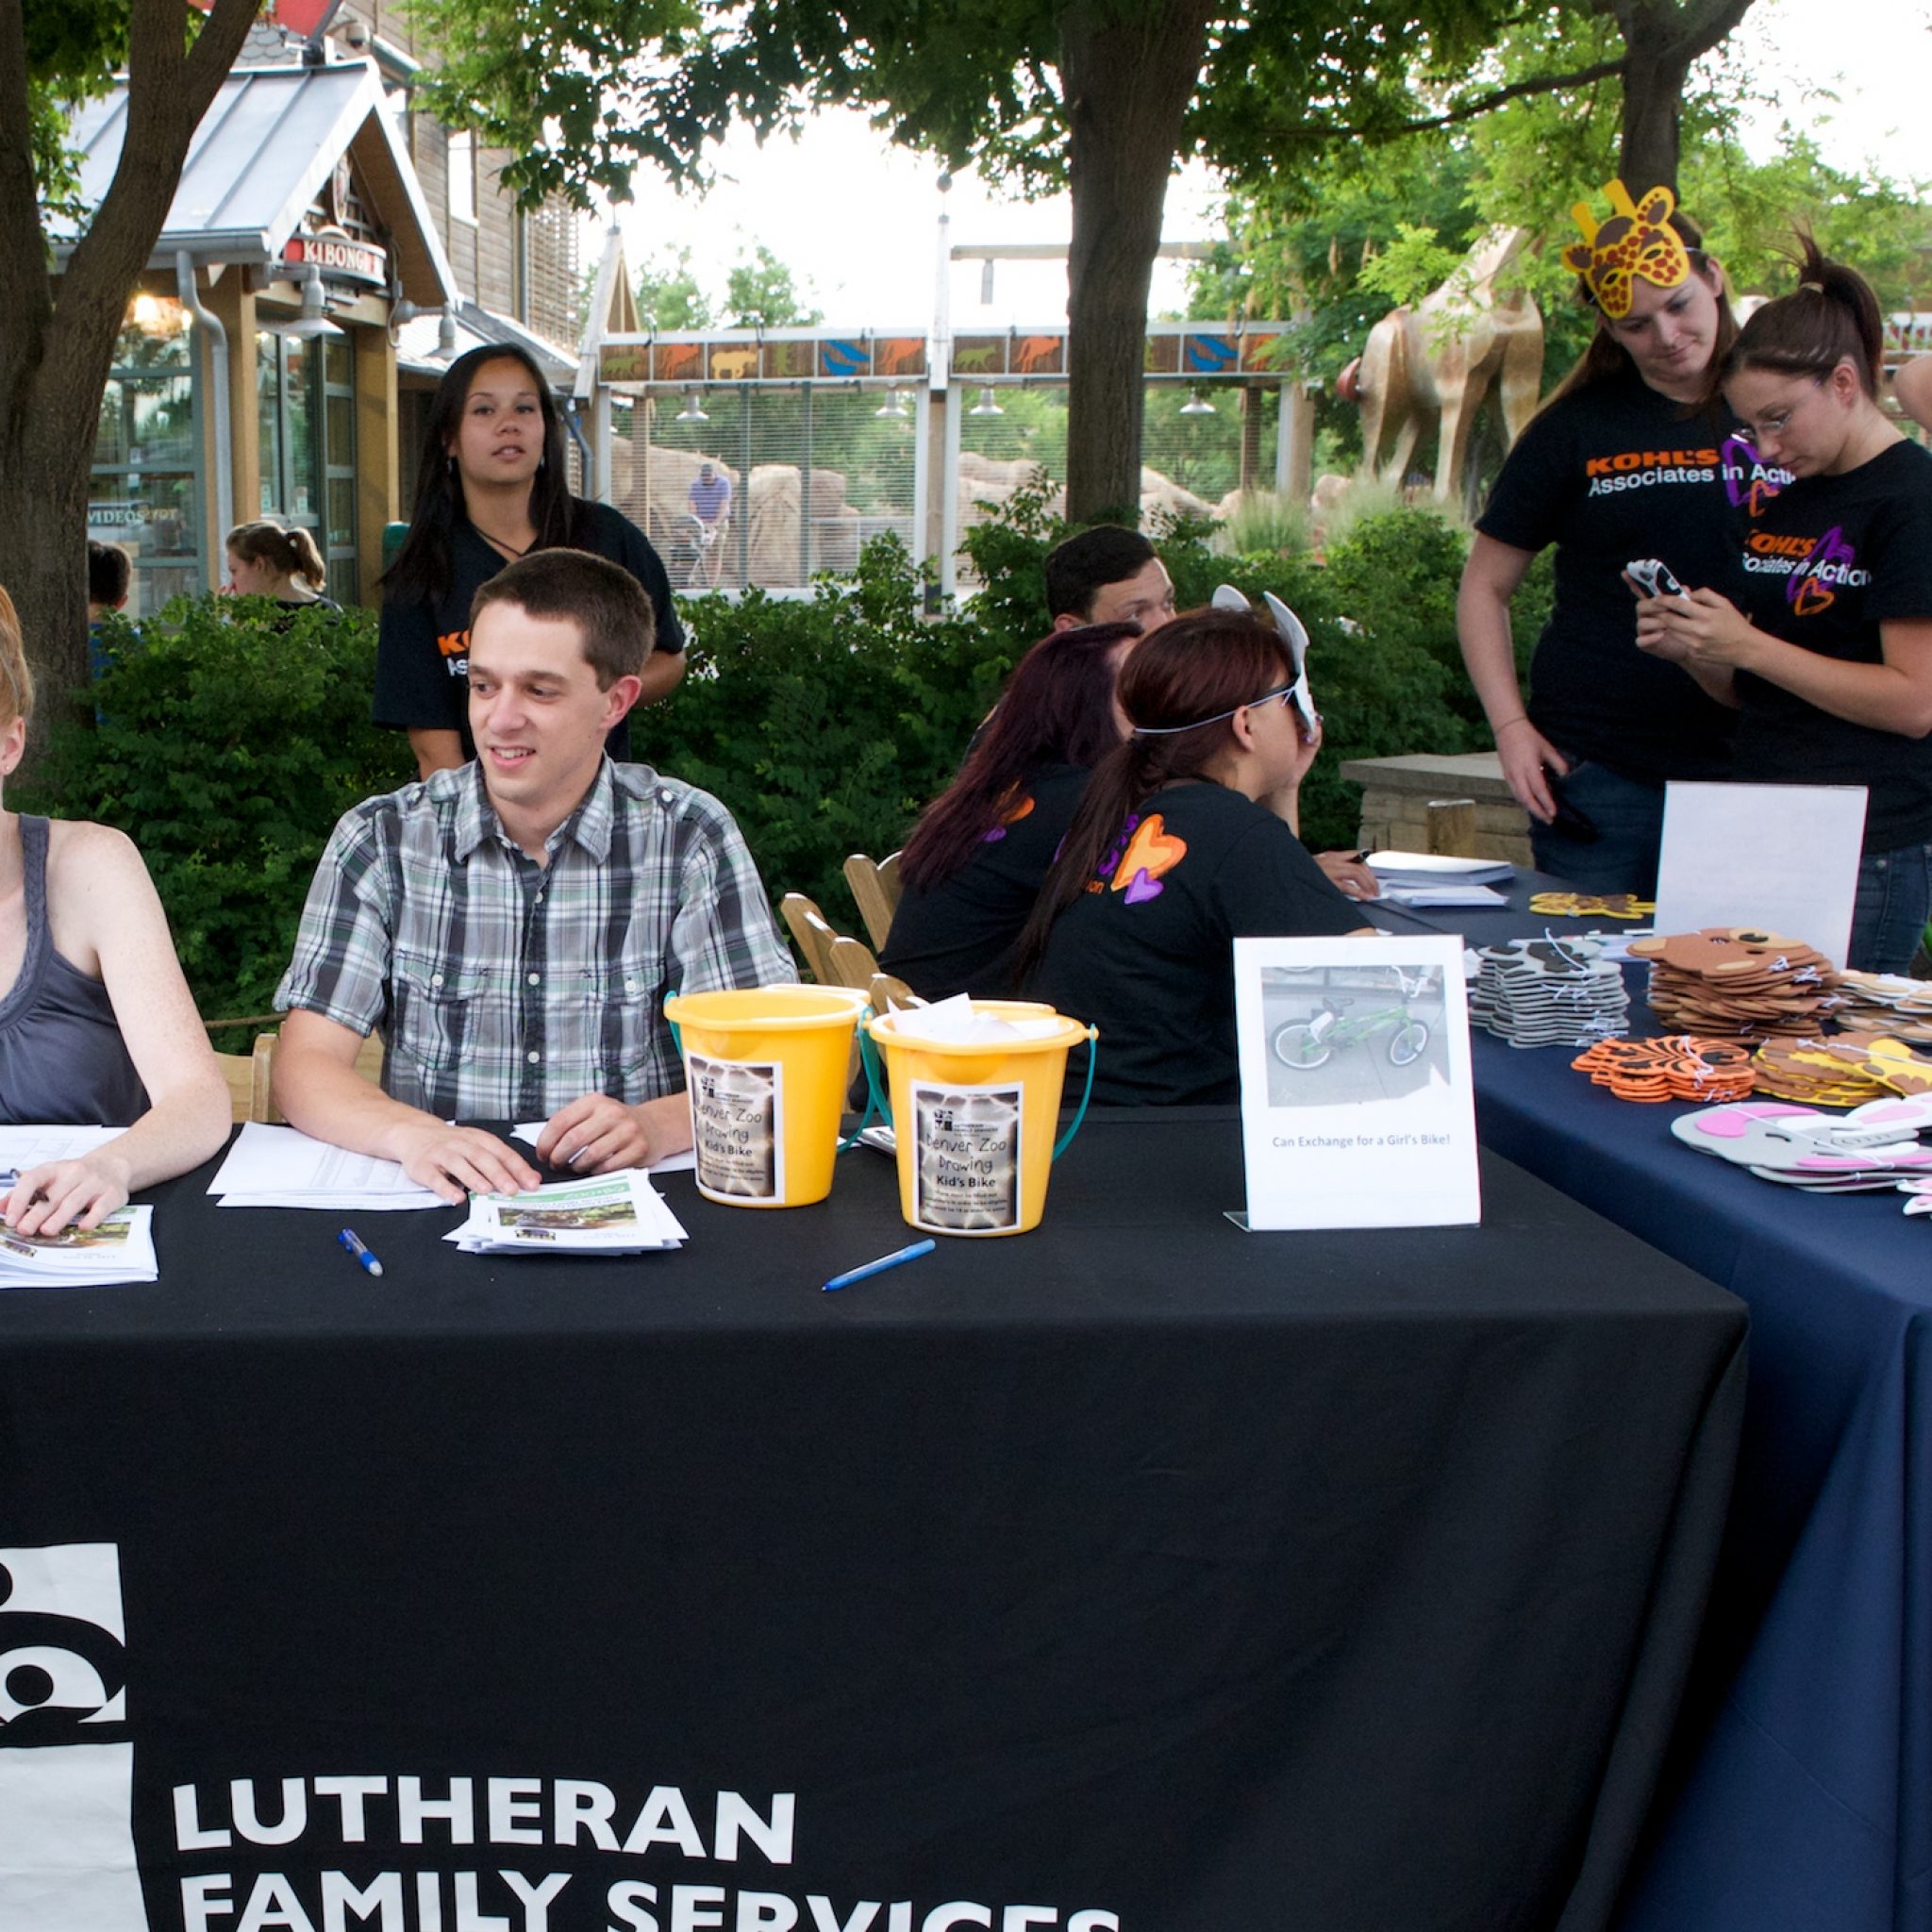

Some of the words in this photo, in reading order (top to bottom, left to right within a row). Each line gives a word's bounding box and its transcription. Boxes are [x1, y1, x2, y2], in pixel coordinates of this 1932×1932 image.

[1586, 449, 1721, 477] KOHL'S
[1589, 466, 1715, 498] Associates
[1722, 463, 1743, 481] in
[1750, 463, 1796, 485] Acti
[1746, 529, 1817, 558] OHL'S
[736, 1108, 762, 1123] Zoo
[727, 1144, 753, 1157] Bike
[979, 1137, 1008, 1152] Zoo
[1272, 1136, 1295, 1148] Can
[1297, 1135, 1354, 1149] Exchange
[1357, 1134, 1374, 1146] for
[1376, 1137, 1385, 1146] a
[1387, 1134, 1418, 1146] Girl's
[1421, 1133, 1451, 1146] Bike!
[939, 1154, 993, 1174] Drawing
[936, 1174, 965, 1188] Kid's
[967, 1175, 996, 1188] Bike
[173, 1775, 796, 1865] LUTHERAN
[180, 1870, 573, 1932] FAMILY
